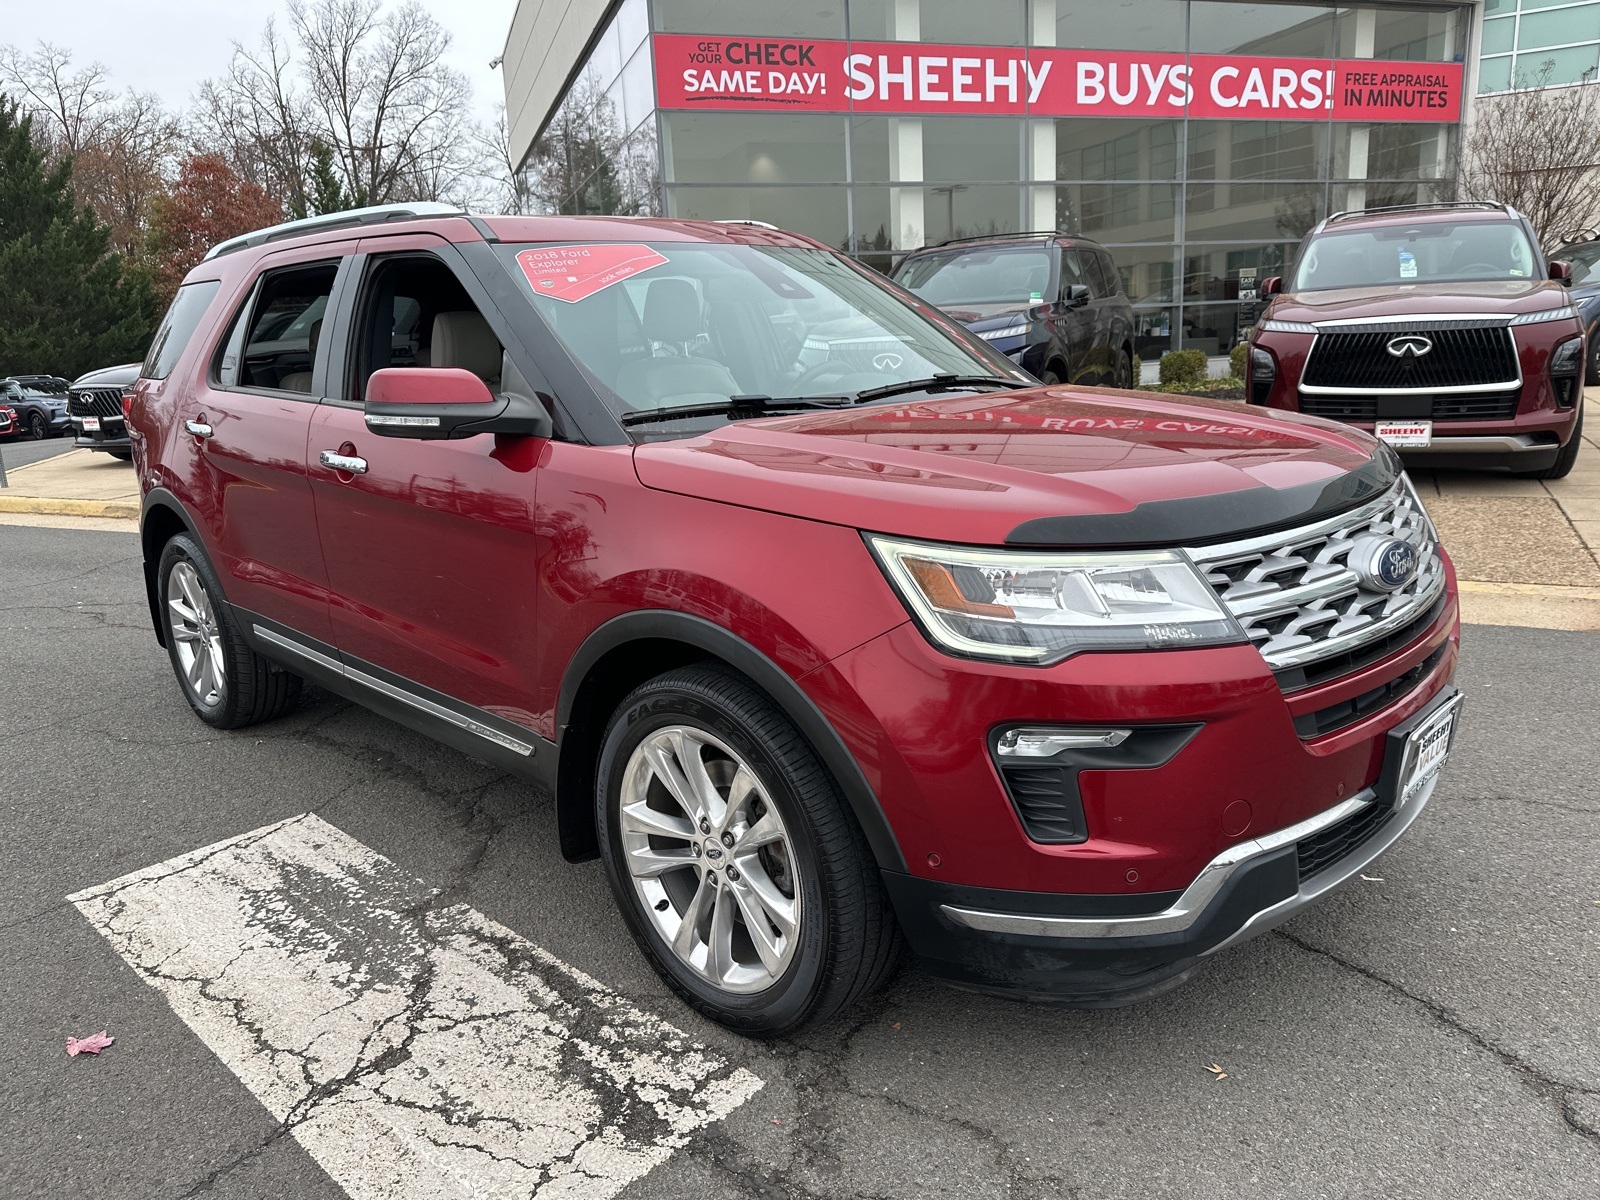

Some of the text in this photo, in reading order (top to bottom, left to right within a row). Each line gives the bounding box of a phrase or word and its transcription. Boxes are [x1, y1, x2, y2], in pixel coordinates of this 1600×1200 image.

[698, 42, 721, 52] GET
[725, 42, 816, 66] CHECK
[688, 53, 722, 64] YOUR
[683, 69, 826, 95] SAME DAY!
[843, 53, 1336, 110] SHEEHY BUYS CARS!
[1345, 72, 1449, 88] FREE APPRAISAL
[1344, 89, 1448, 108] IN MINUTES
[524, 249, 591, 262] 2018 Ford
[528, 258, 579, 270] Explorer
[534, 267, 567, 275] Limited
[1389, 546, 1414, 578] Ford
[627, 698, 702, 727] EAGLE
